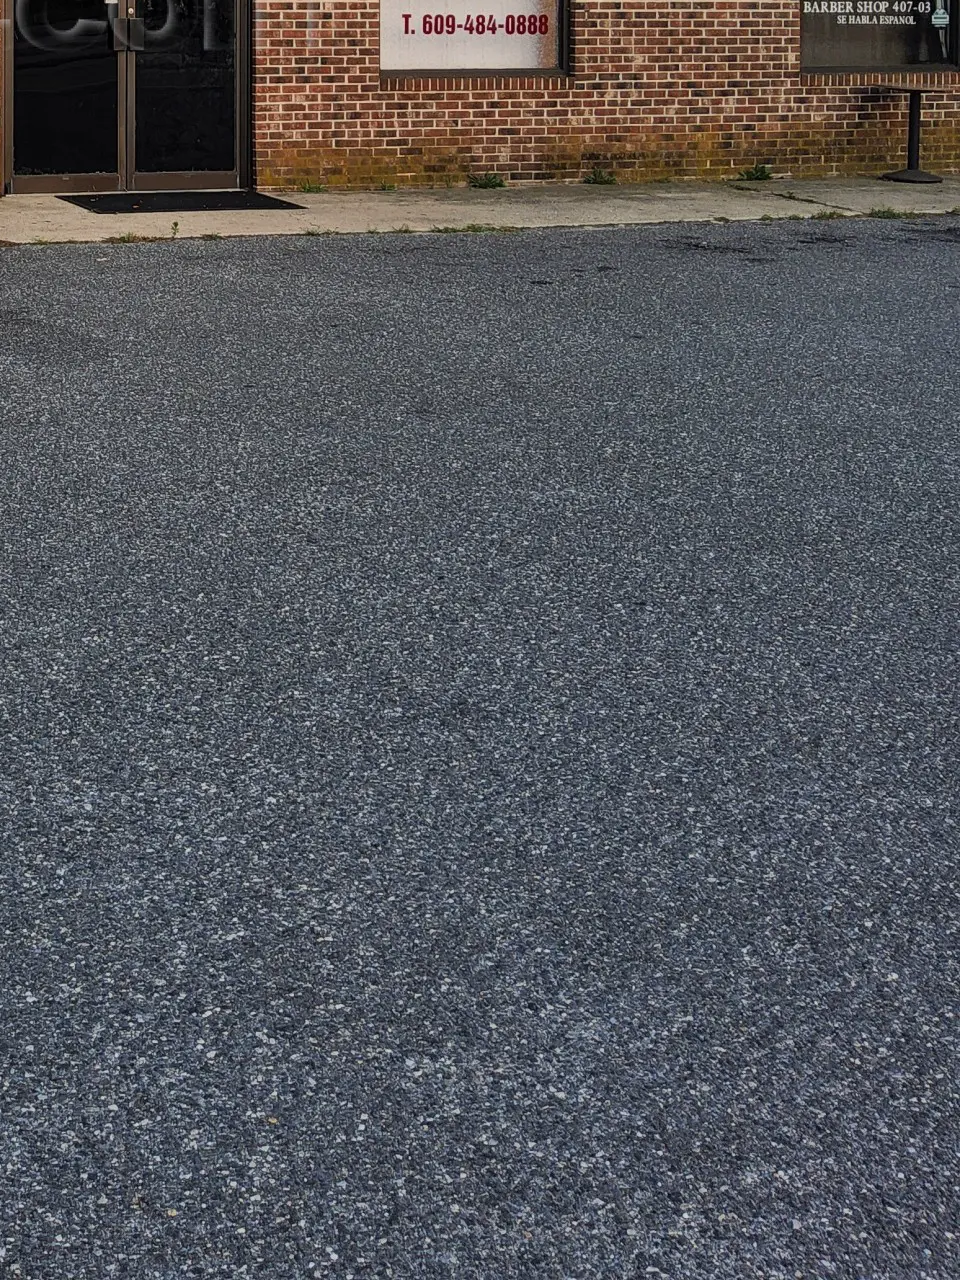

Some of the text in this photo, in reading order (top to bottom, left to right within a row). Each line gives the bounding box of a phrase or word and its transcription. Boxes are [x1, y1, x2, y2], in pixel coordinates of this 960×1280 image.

[803, 1, 931, 13] BARBER SHOP 407-03
[402, 14, 549, 35] T. 609-484-0888
[837, 15, 847, 24] SE
[848, 15, 878, 24] HABLA
